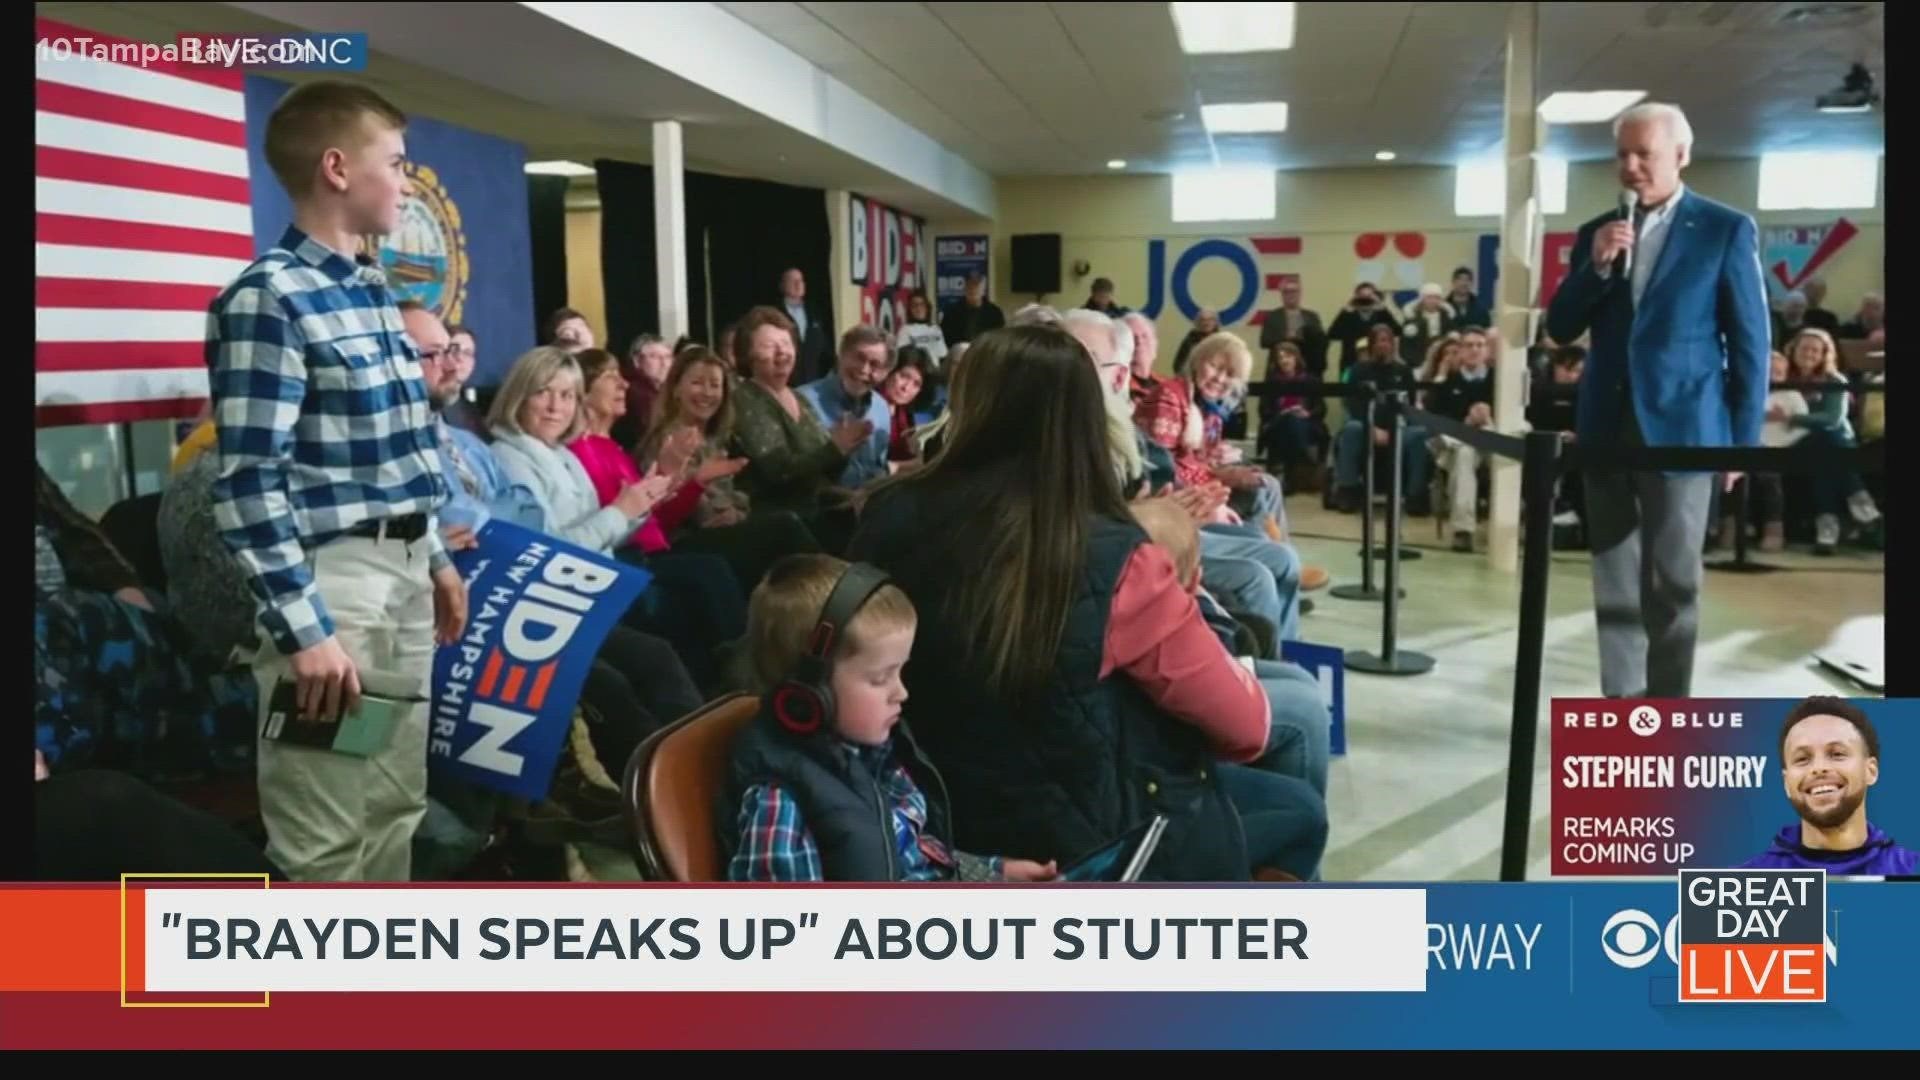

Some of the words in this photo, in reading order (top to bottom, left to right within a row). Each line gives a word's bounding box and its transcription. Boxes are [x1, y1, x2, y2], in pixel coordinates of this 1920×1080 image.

[852, 198, 927, 290] BIDEN
[1141, 237, 1303, 327] JOE
[505, 542, 550, 584] NEW
[430, 585, 515, 757] HAMPSHIRE
[457, 551, 620, 777] BIDEN
